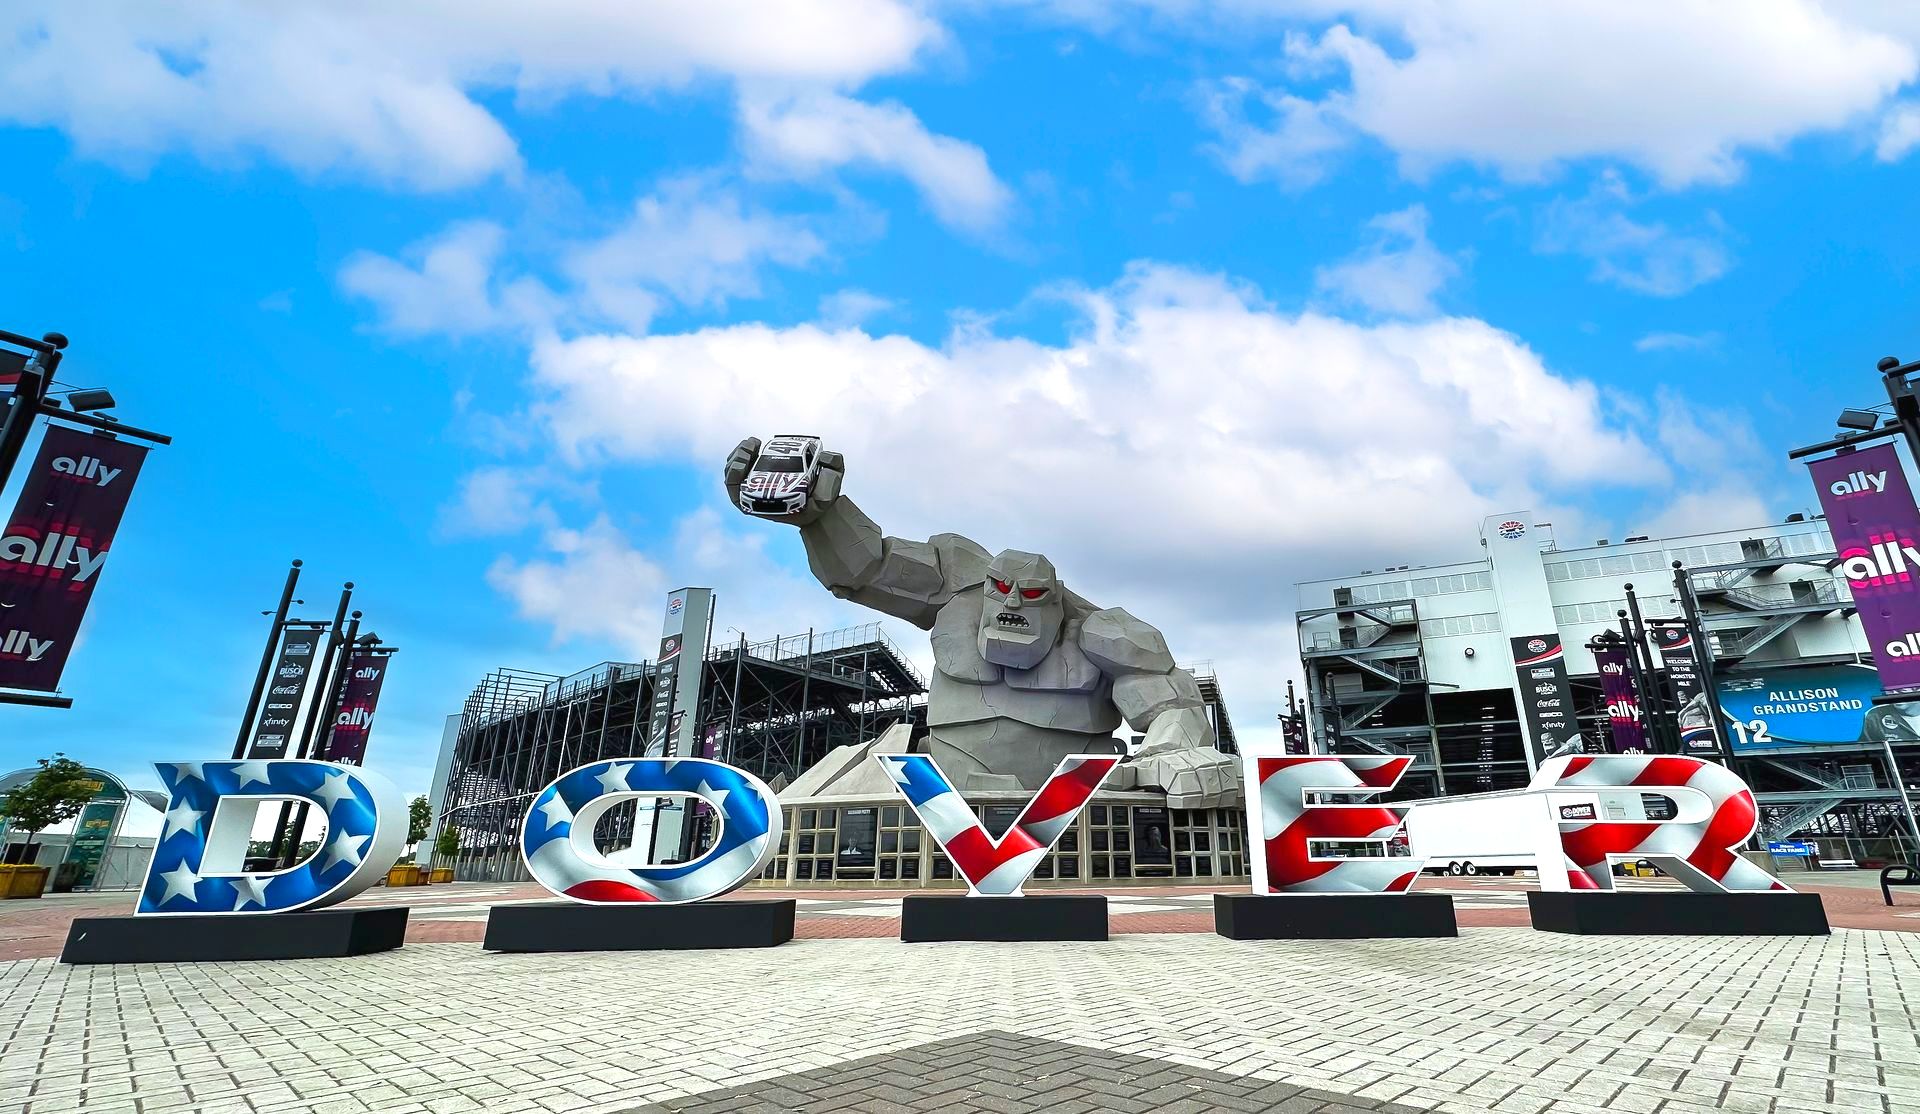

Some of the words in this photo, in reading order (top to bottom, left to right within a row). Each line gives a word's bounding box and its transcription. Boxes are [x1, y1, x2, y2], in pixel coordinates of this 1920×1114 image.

[51, 455, 121, 486] ally
[749, 471, 797, 493] ally
[1830, 470, 1887, 495] ally
[0, 532, 109, 581] ally
[0, 629, 54, 661] lly
[279, 667, 305, 676] BUSCH
[355, 667, 380, 681] ally
[1602, 662, 1624, 676] ally
[1535, 684, 1558, 694] BUSCH
[1769, 687, 1839, 702] ALLISON
[1607, 701, 1639, 722] ally
[1753, 699, 1863, 715] GRANDSTAND
[263, 718, 290, 727] xfinity
[337, 707, 375, 730] ally
[1541, 721, 1566, 730] xfinity
[1731, 719, 1772, 744] 12
[134, 752, 1798, 917] DOVER
